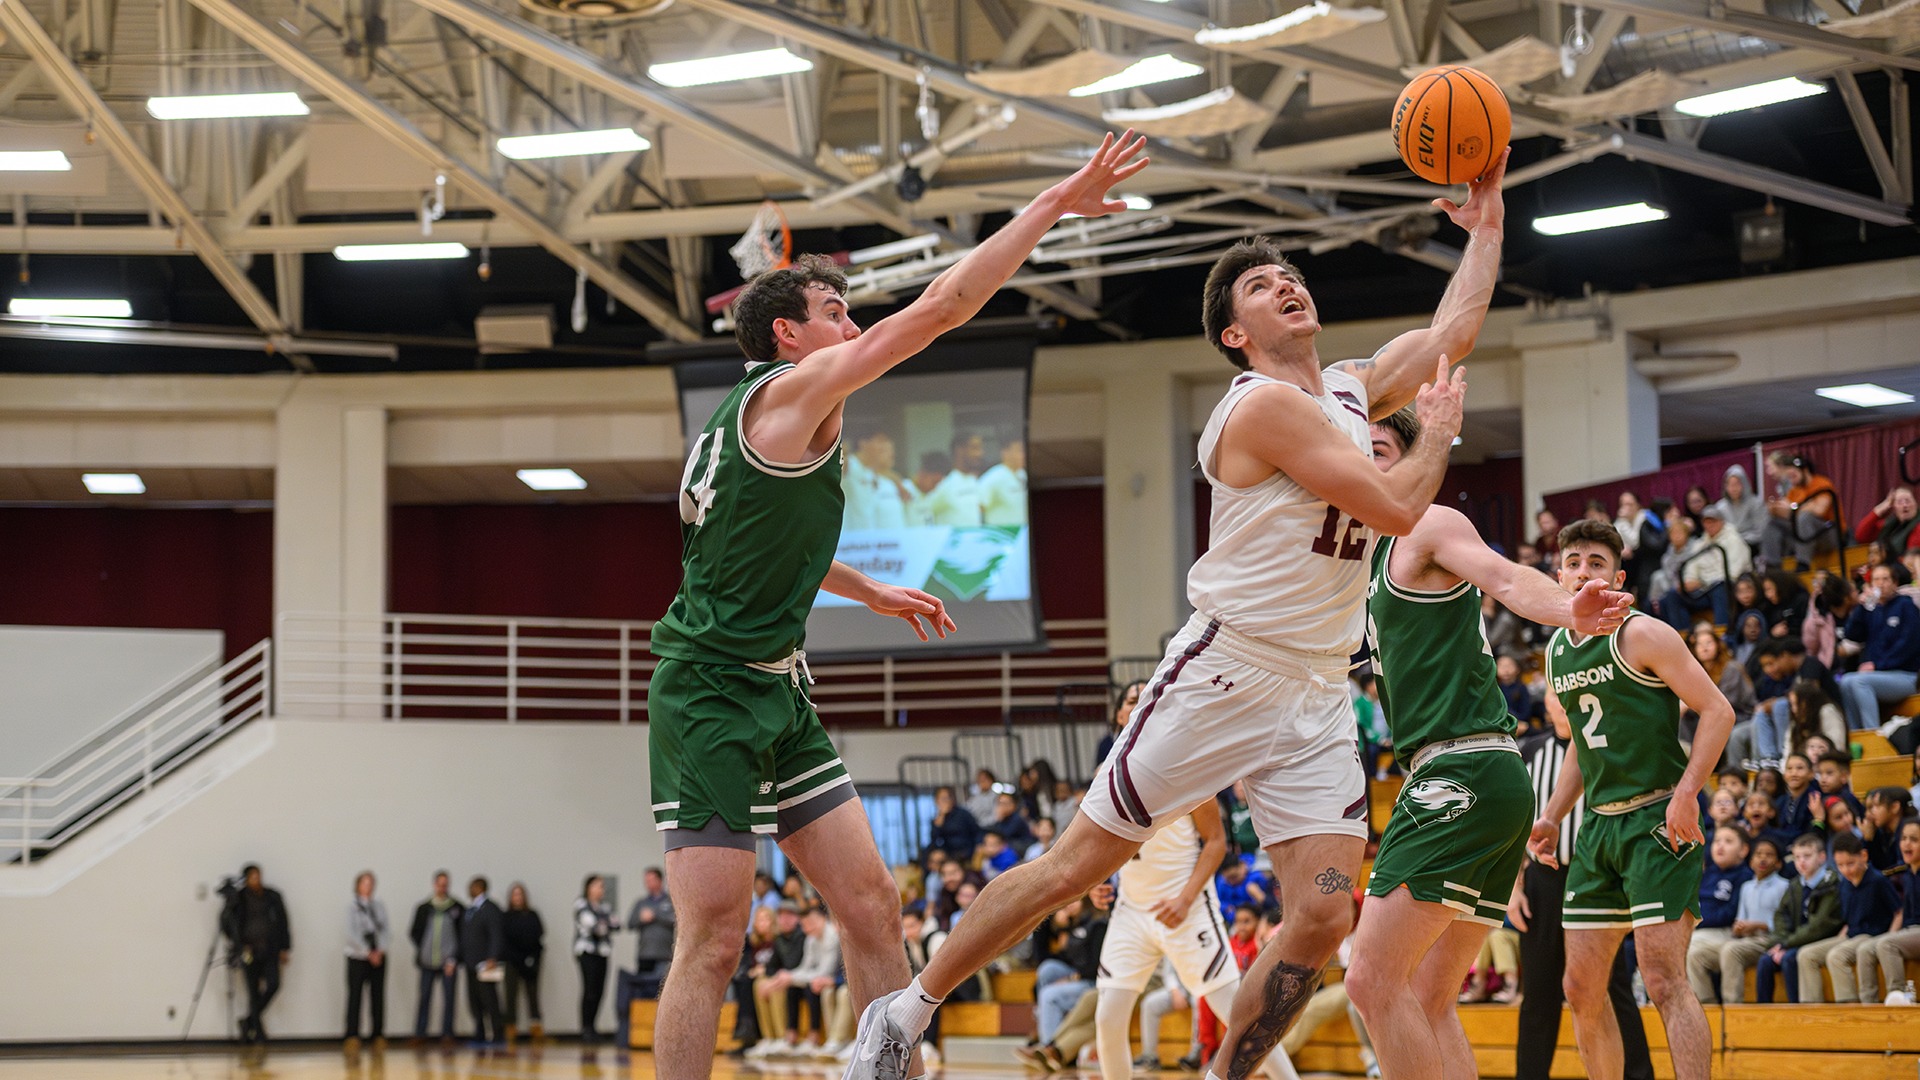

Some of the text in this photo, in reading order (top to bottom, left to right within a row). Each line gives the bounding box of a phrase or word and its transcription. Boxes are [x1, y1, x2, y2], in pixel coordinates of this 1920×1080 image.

[1393, 96, 1412, 153] ilson
[1419, 122, 1435, 168] EVO
[1311, 504, 1367, 561] 12
[1554, 664, 1614, 694] BABSON
[1579, 693, 1608, 749] 2
